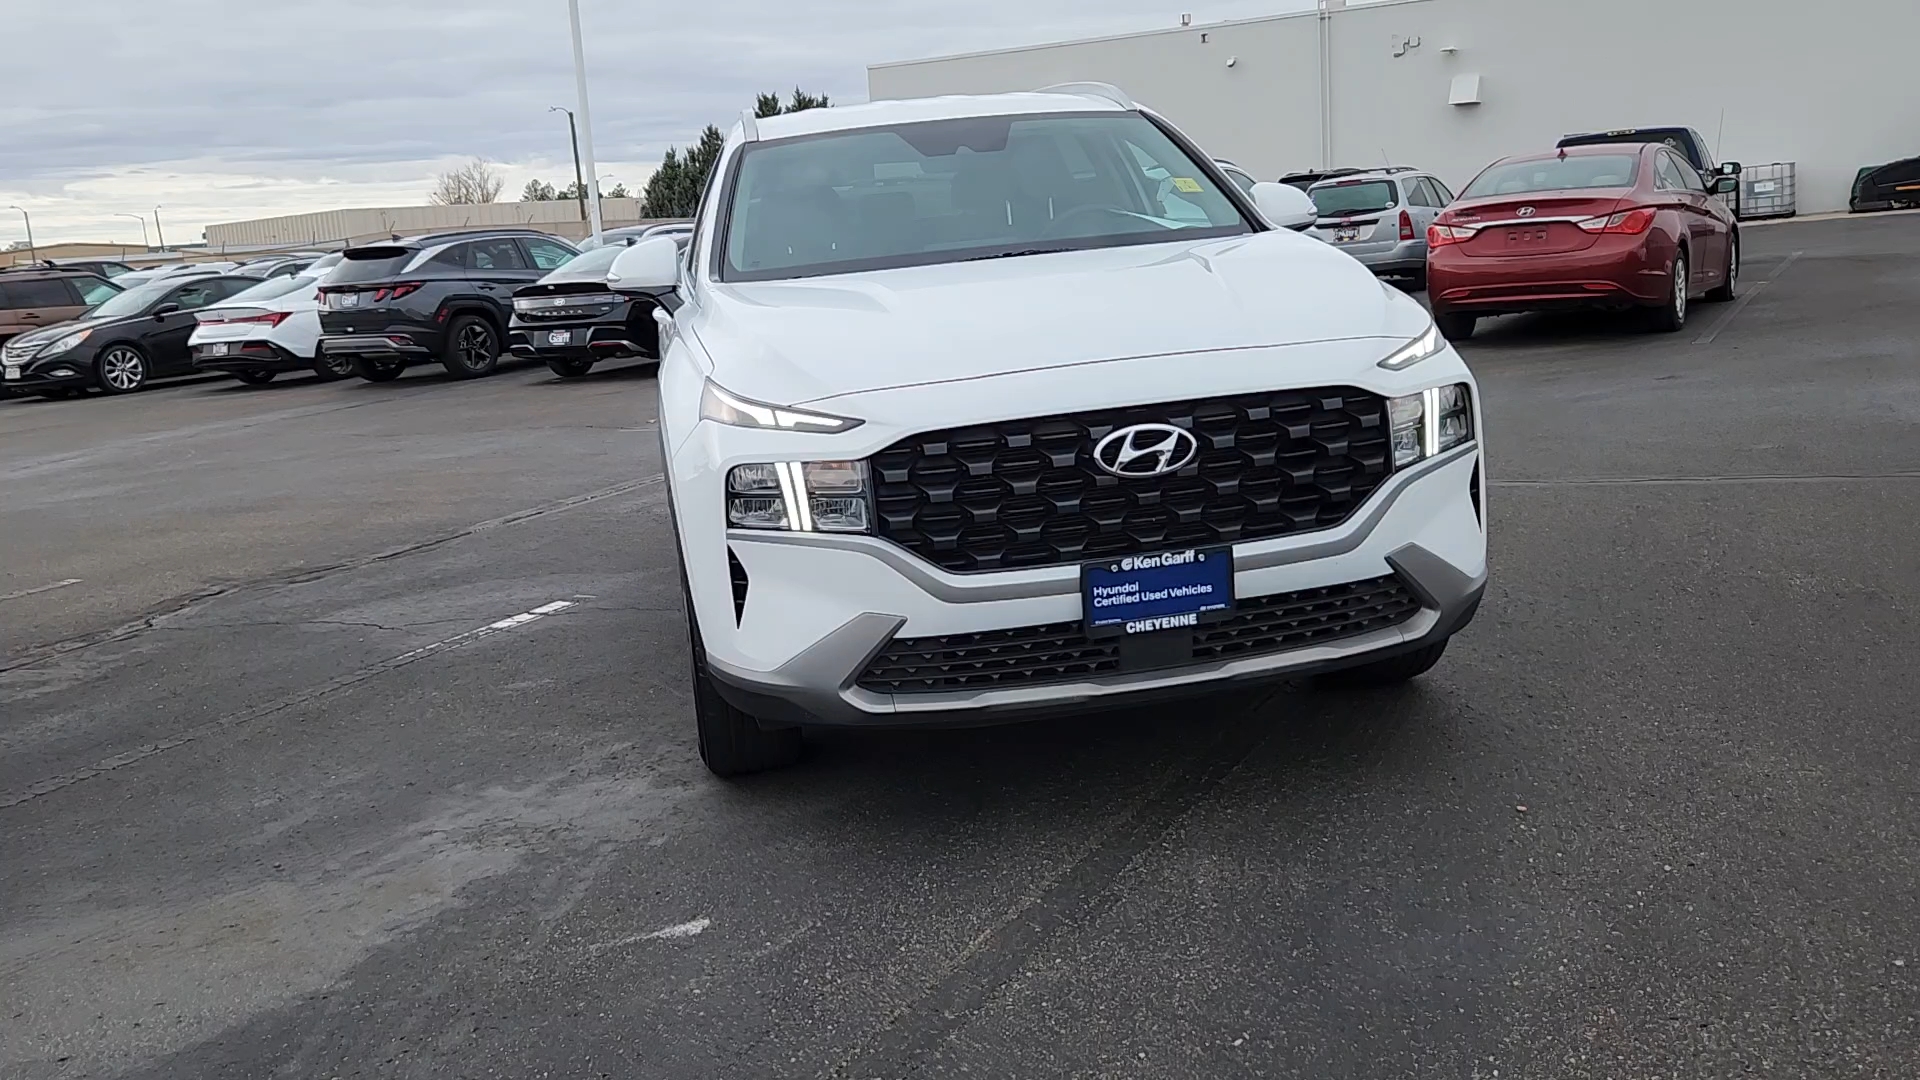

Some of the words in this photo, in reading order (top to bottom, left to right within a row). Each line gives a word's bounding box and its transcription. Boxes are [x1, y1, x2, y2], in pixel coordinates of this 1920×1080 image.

[1133, 555, 1161, 570] Ken
[1161, 549, 1195, 566] Garff
[1093, 581, 1139, 597] Hyundai
[1093, 591, 1140, 607] Certified
[1141, 589, 1168, 602] Used
[1169, 584, 1213, 598] Vehicles
[1126, 613, 1198, 634] CHEYENNE
